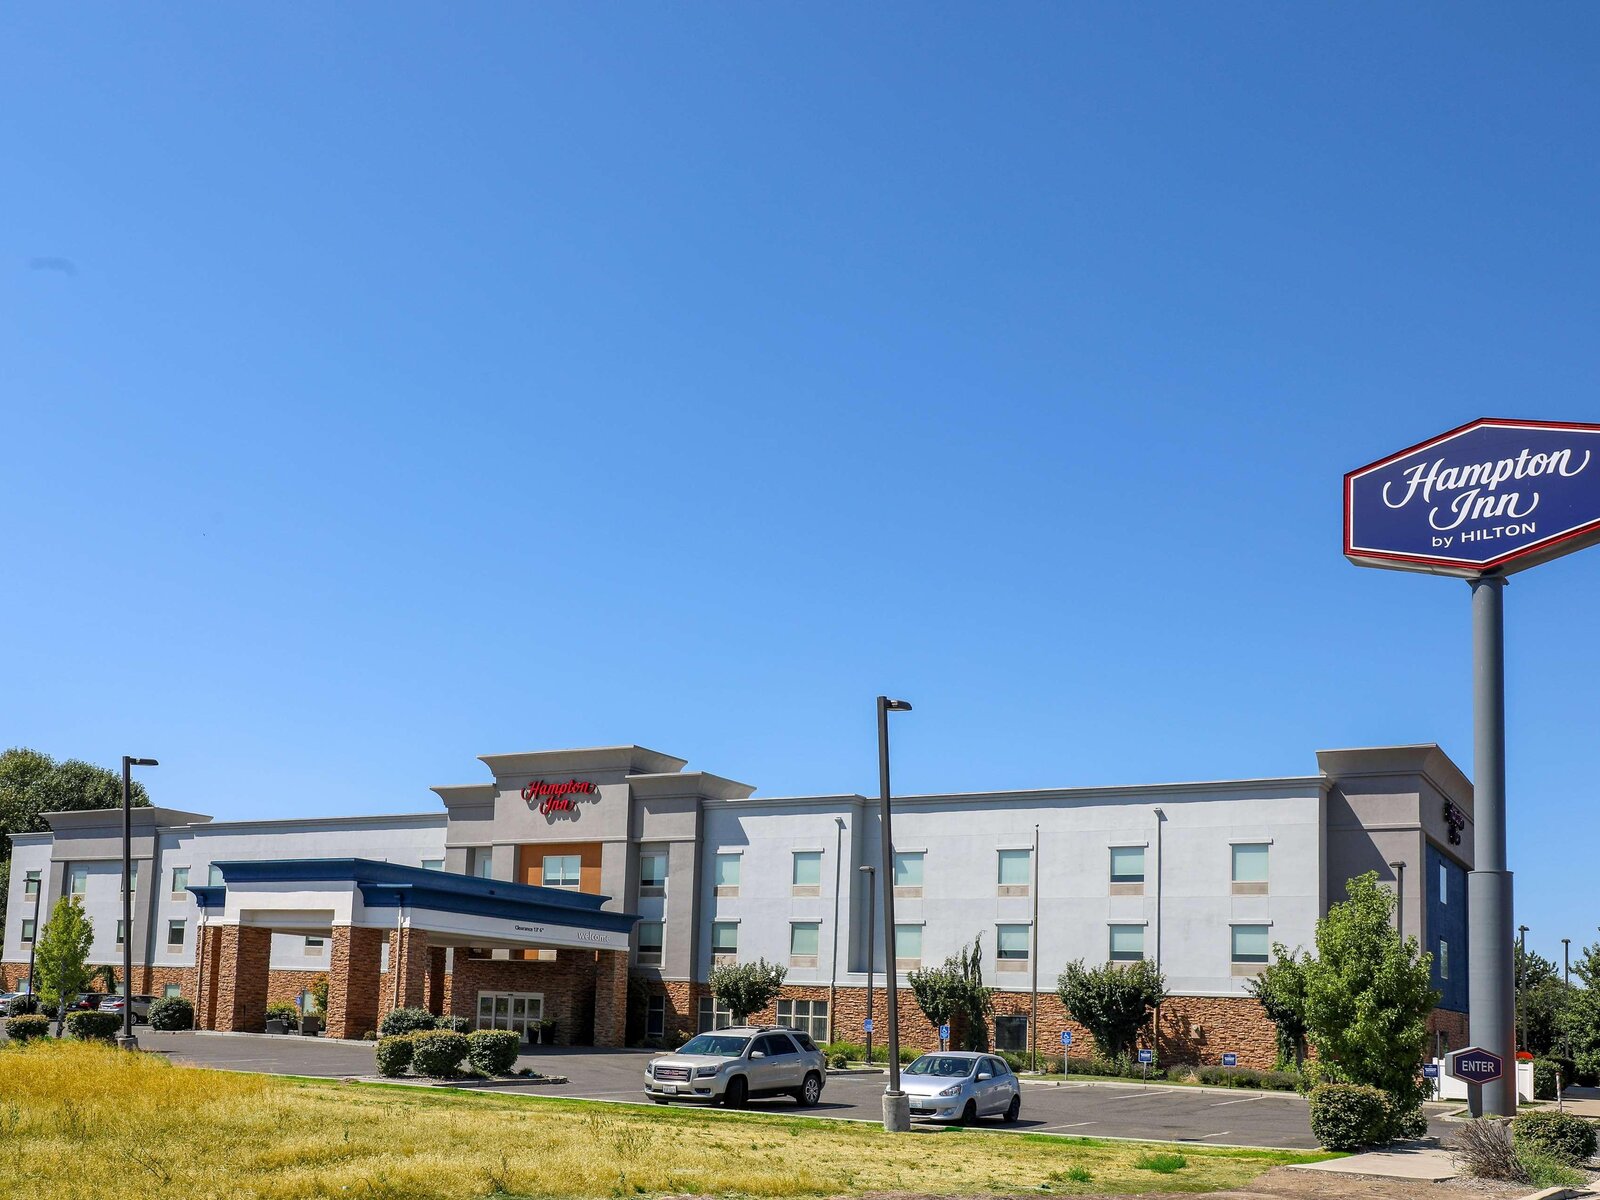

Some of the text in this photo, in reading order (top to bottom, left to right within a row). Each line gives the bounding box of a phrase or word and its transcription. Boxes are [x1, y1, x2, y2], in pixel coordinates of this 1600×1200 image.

[1382, 448, 1590, 508] Hampton
[1428, 488, 1539, 531] Inn
[1432, 522, 1536, 548] by HILTON
[521, 779, 597, 801] Hampton
[539, 796, 576, 815] Inn
[576, 931, 610, 942] welcome
[1462, 1060, 1495, 1072] ENTER
